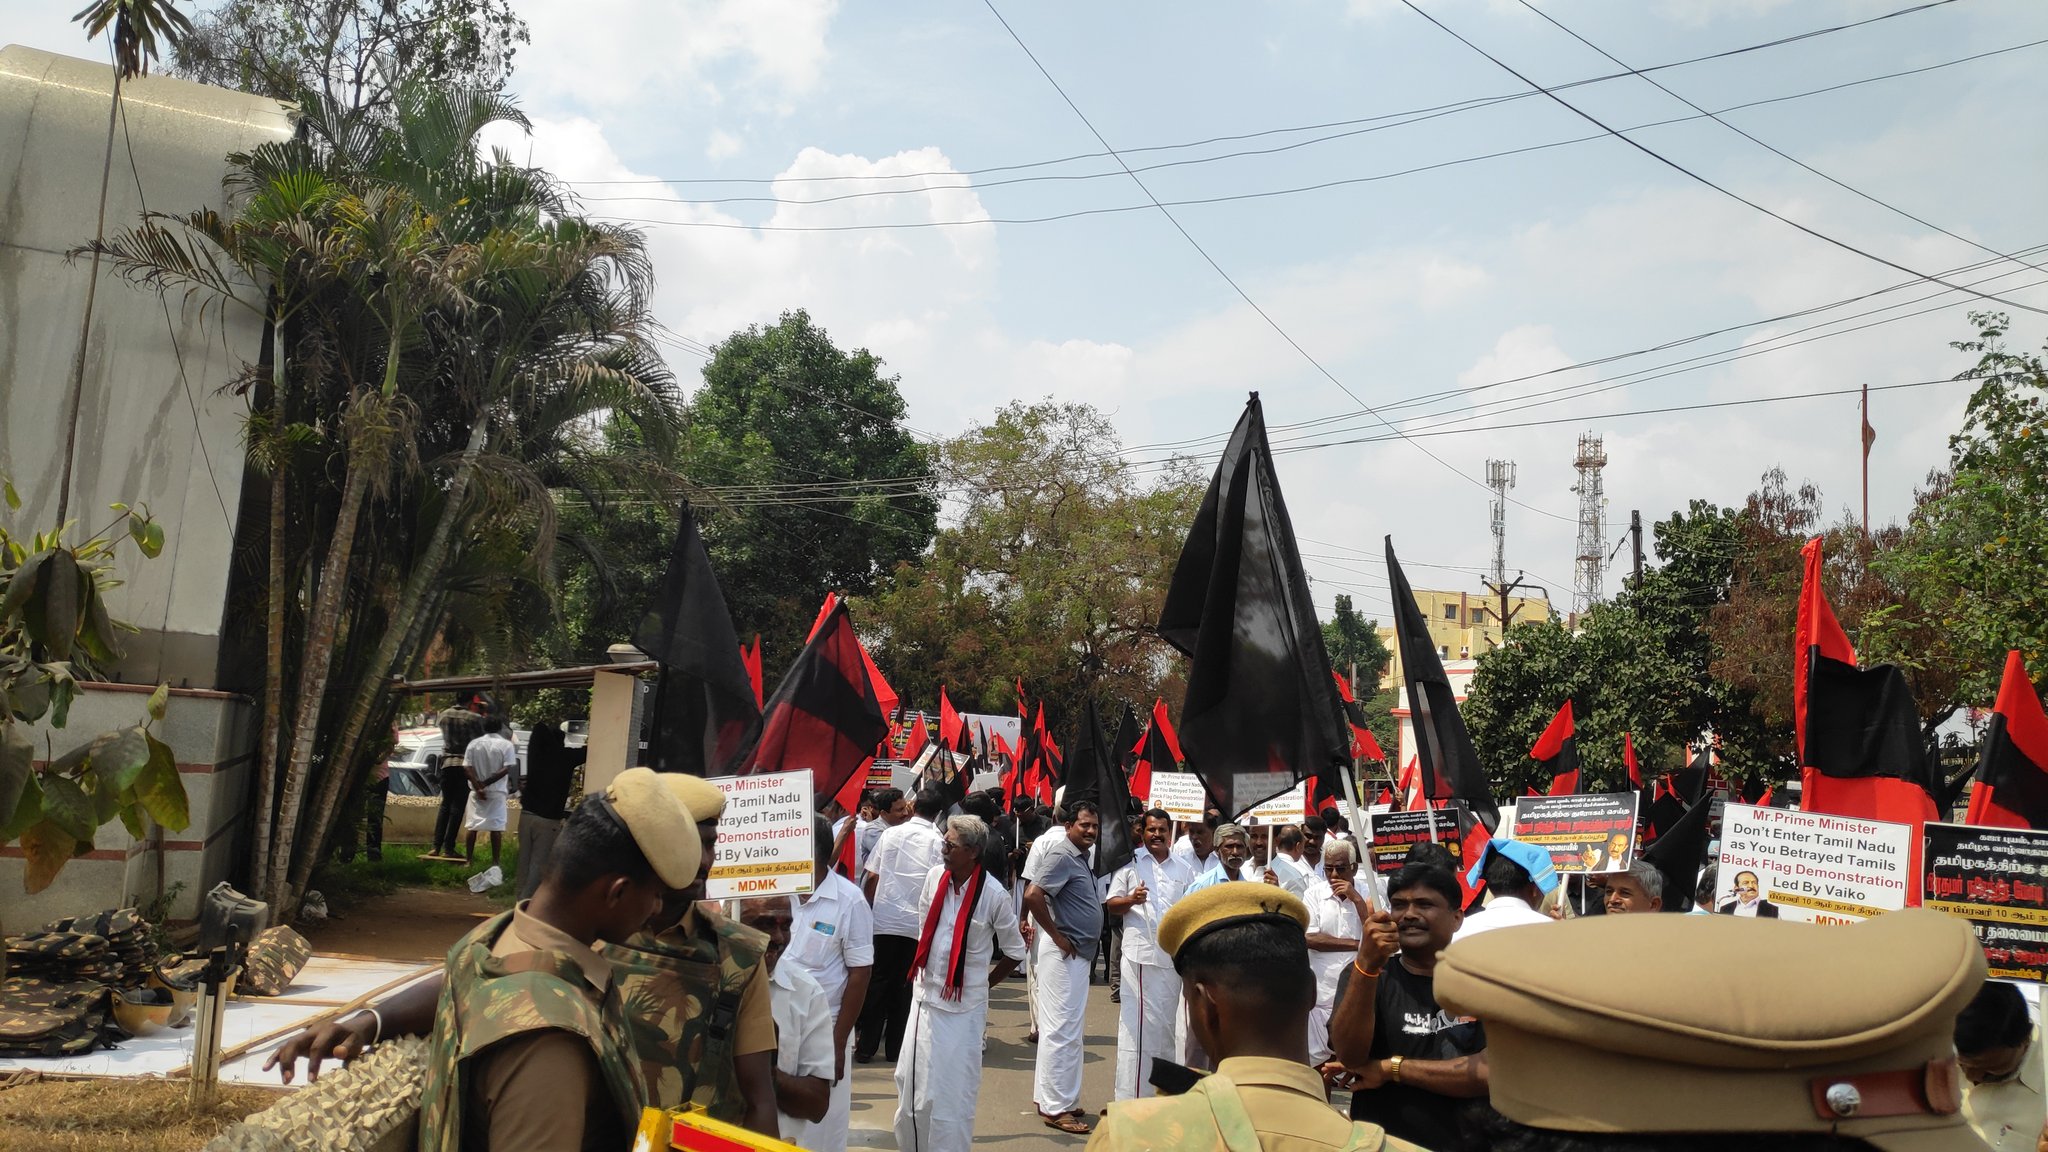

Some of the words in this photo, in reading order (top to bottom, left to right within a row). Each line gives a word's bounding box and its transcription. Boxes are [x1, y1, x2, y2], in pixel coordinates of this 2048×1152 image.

[735, 778, 784, 791] Minister
[732, 795, 764, 808] Tamil
[769, 792, 800, 805] Nadu
[761, 809, 802, 822] Tamils
[1753, 810, 1814, 827] Mr.Prime
[1819, 818, 1877, 835] Minister
[718, 827, 809, 843] Demonstration
[1774, 829, 1810, 841] Enter
[1814, 834, 1853, 849] Tamil
[1857, 840, 1895, 854] Nadu
[725, 849, 740, 862] By
[744, 846, 779, 858] Vaiko
[1730, 840, 1745, 850] as
[1750, 841, 1775, 854] You
[1780, 847, 1843, 864] Betrayed
[1847, 854, 1896, 871] Tamils
[1721, 854, 1758, 868] Black
[1762, 859, 1792, 875] Flag
[1796, 864, 1903, 889] Demonstration
[1935, 855, 2035, 874] தமிழகத்திற்கு
[738, 879, 777, 892] MDMK
[1773, 877, 1798, 890] Led
[1802, 882, 1821, 896] By
[1825, 885, 1866, 900] Vaiko
[1953, 905, 1992, 917] பிப்ரவரி
[2011, 912, 2035, 920] ஆம்
